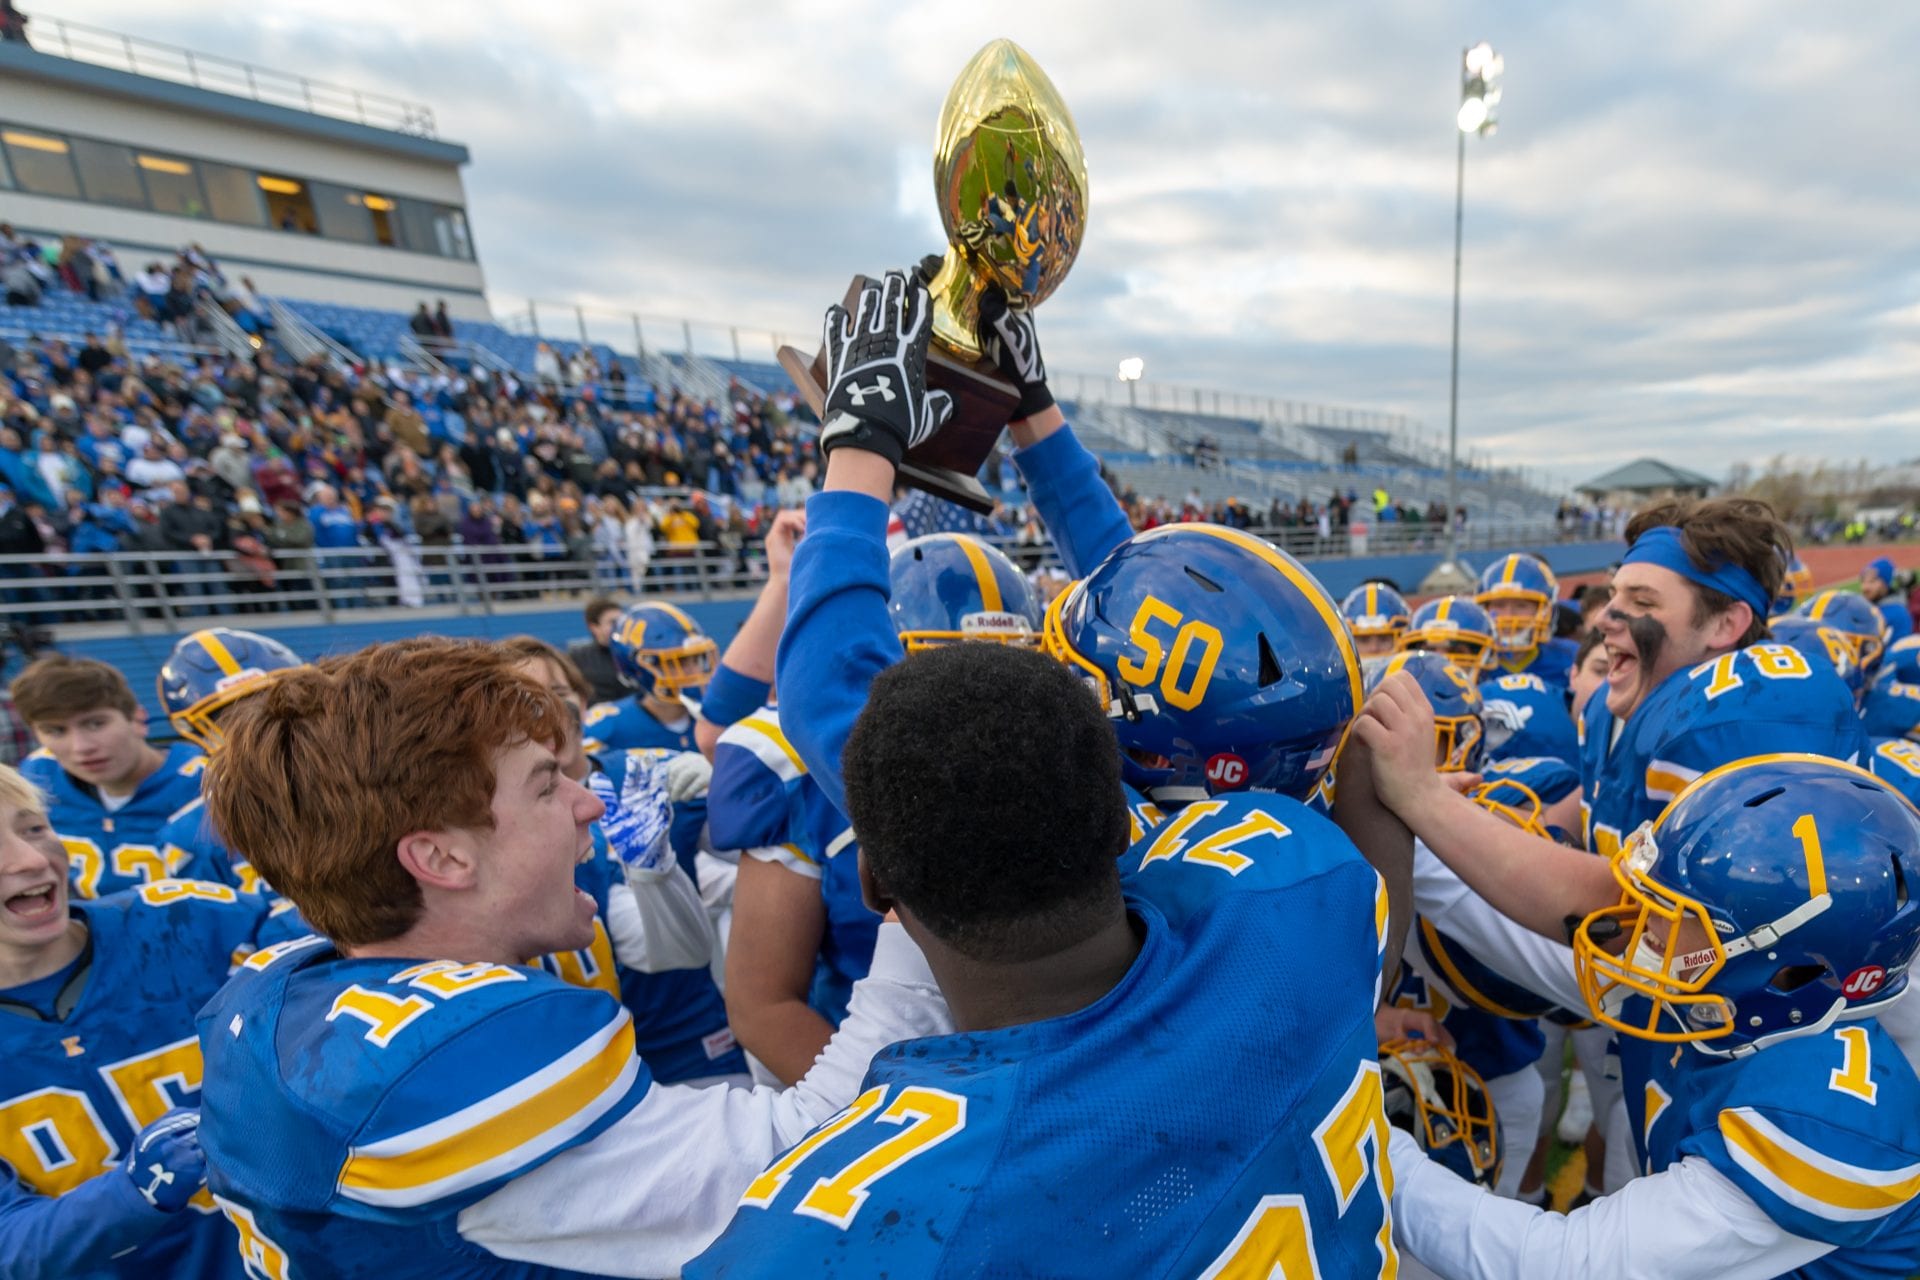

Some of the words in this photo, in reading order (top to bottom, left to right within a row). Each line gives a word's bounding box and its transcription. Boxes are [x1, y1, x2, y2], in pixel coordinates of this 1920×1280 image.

[977, 616, 1015, 627] Riddell
[1117, 595, 1224, 712] 50
[1688, 644, 1813, 700] 78
[1208, 758, 1243, 784] JC
[1791, 814, 1827, 900] 1
[1845, 969, 1882, 993] JC
[1828, 1026, 1878, 1106] 1
[737, 1083, 967, 1231] 77
